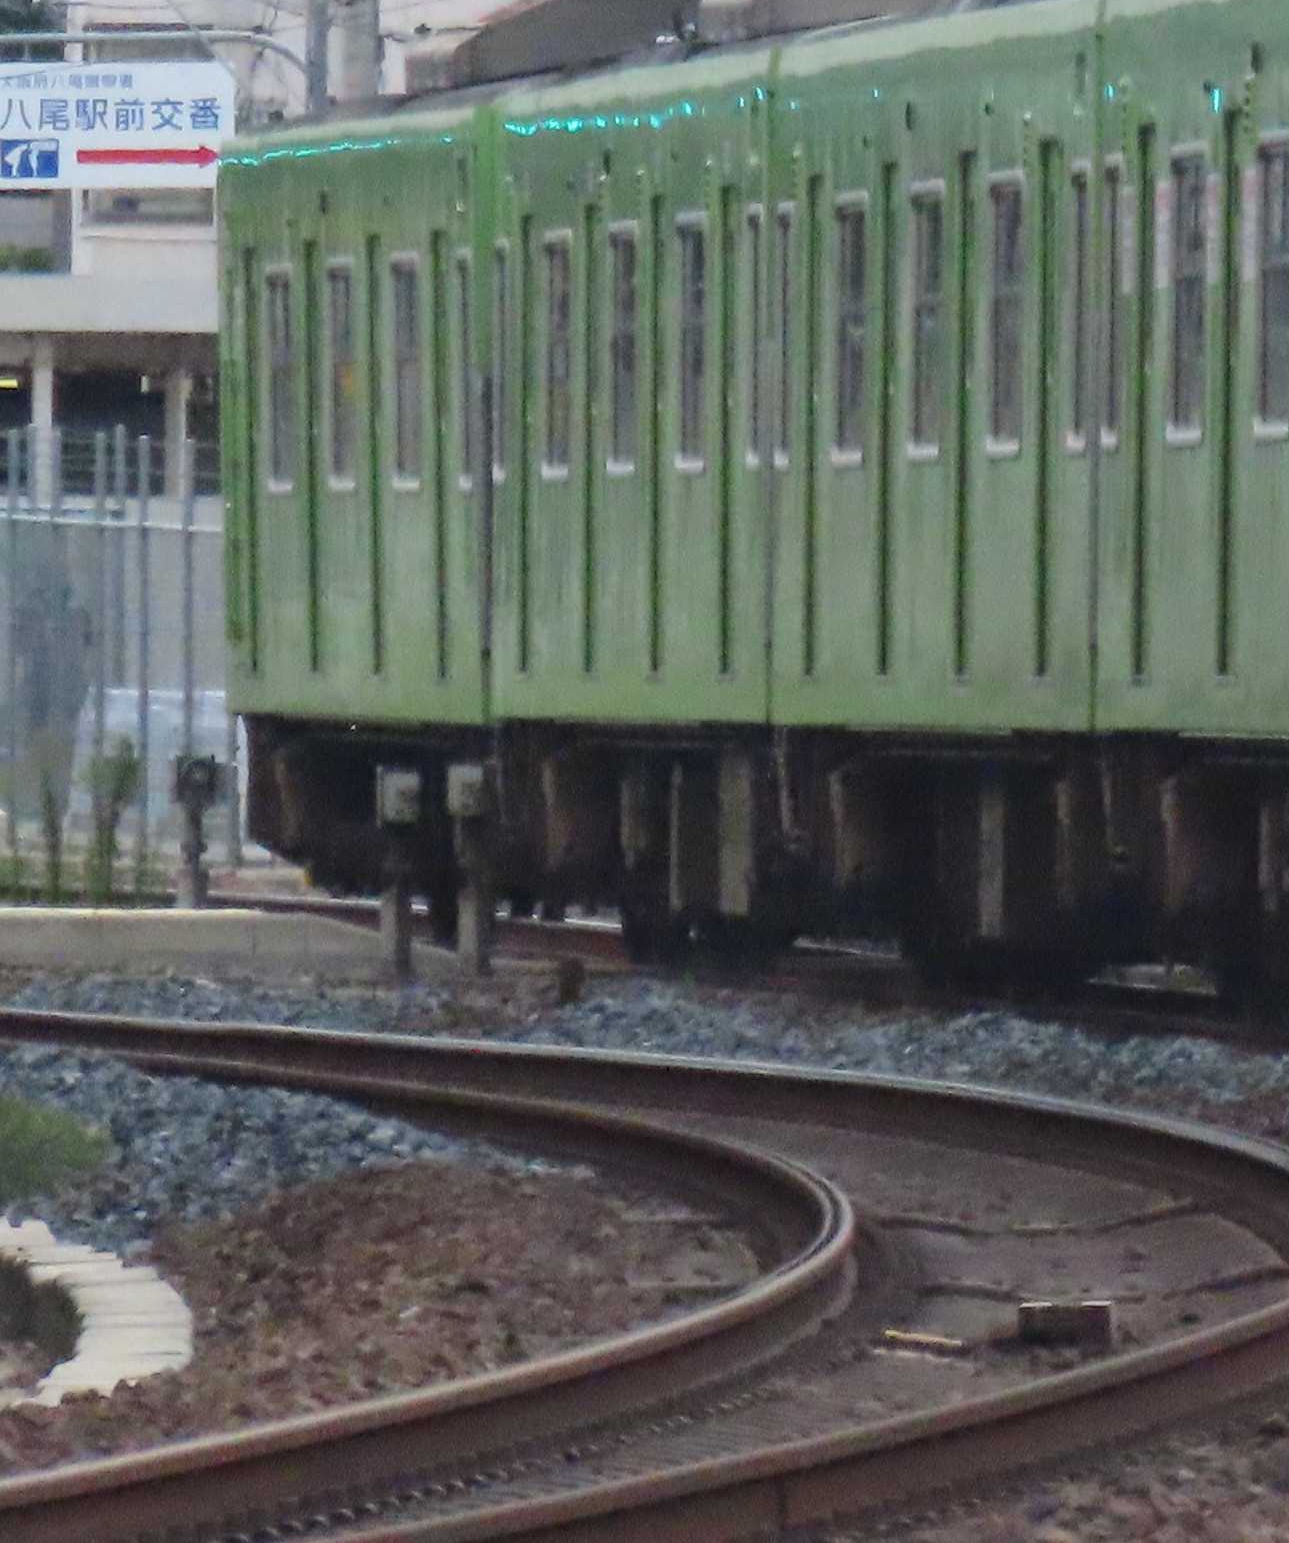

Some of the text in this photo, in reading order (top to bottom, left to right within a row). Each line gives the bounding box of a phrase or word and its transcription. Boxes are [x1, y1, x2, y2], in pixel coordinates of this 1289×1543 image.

[0, 97, 220, 131] 八尾駅前交番
